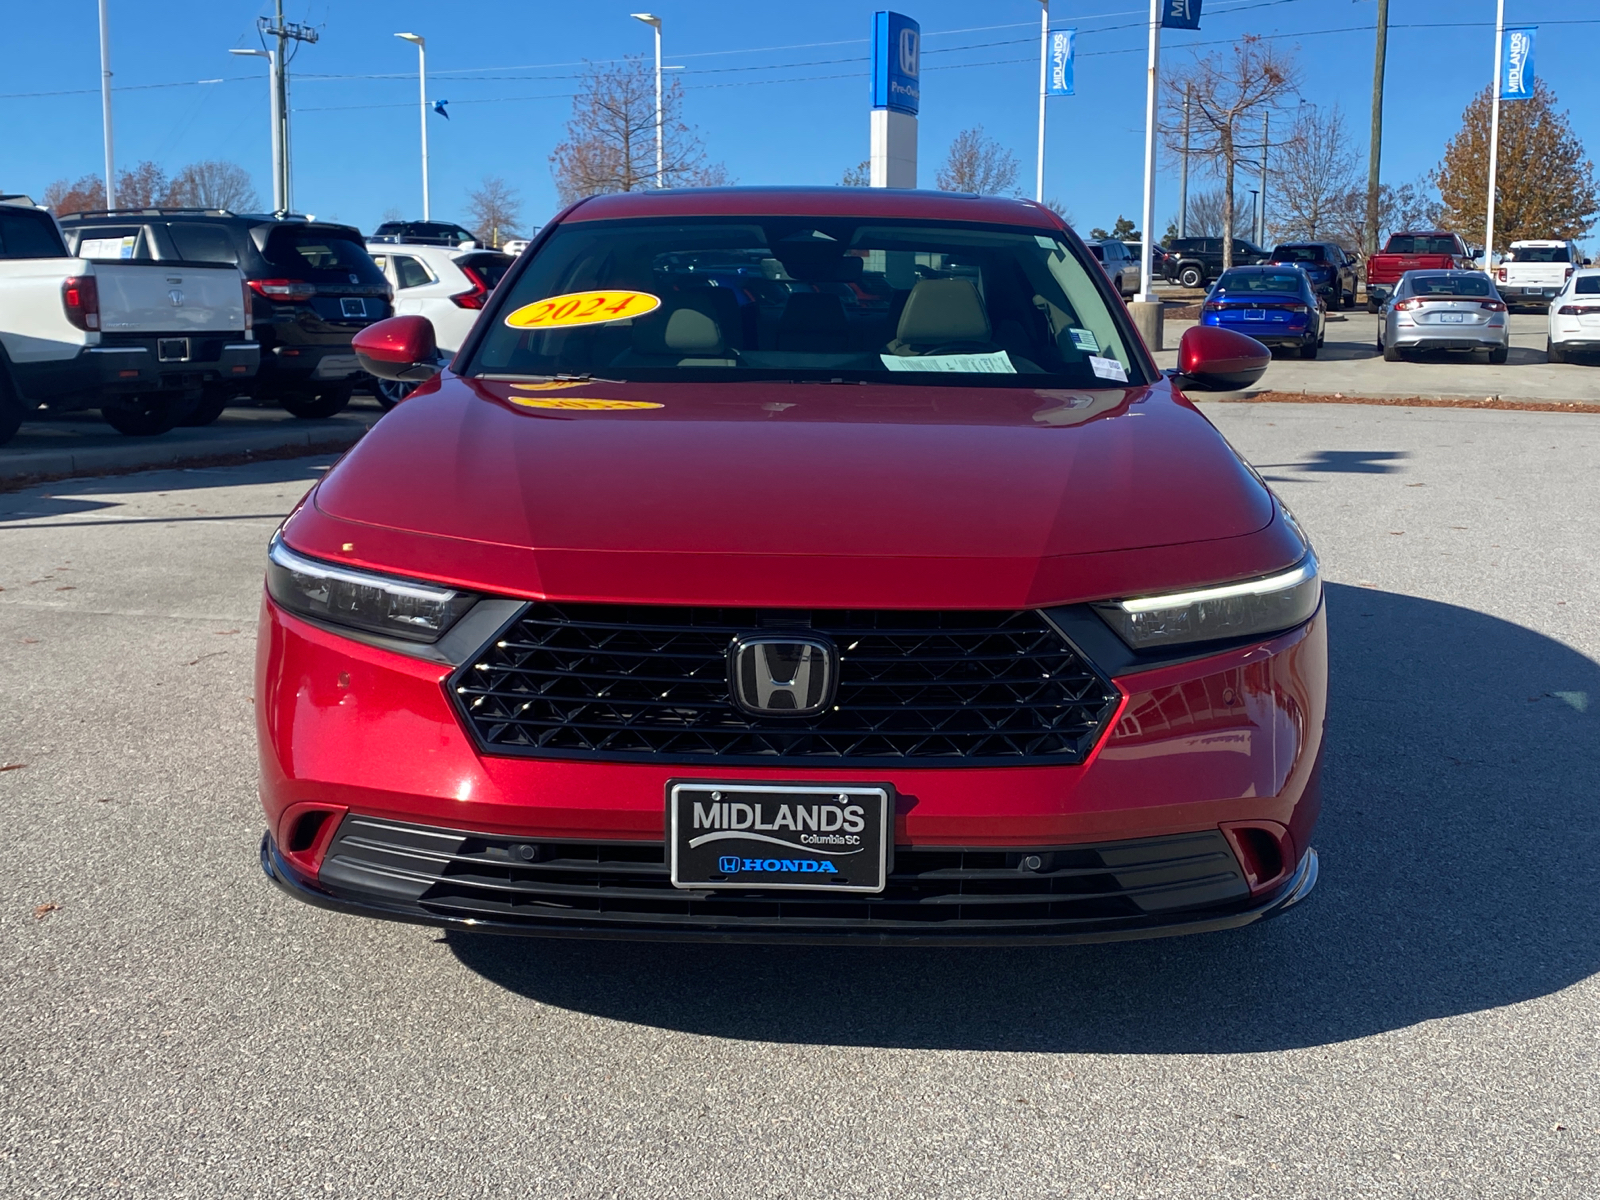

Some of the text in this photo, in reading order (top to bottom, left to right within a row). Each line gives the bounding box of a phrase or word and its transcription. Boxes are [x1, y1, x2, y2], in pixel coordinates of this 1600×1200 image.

[1053, 33, 1064, 90] MIDLANDS
[1508, 32, 1522, 93] MIDLANDS
[523, 295, 637, 325] 2024
[693, 801, 865, 833] MIDLANDS
[800, 833, 860, 845] Columbia SC
[741, 858, 838, 873] HONDA
